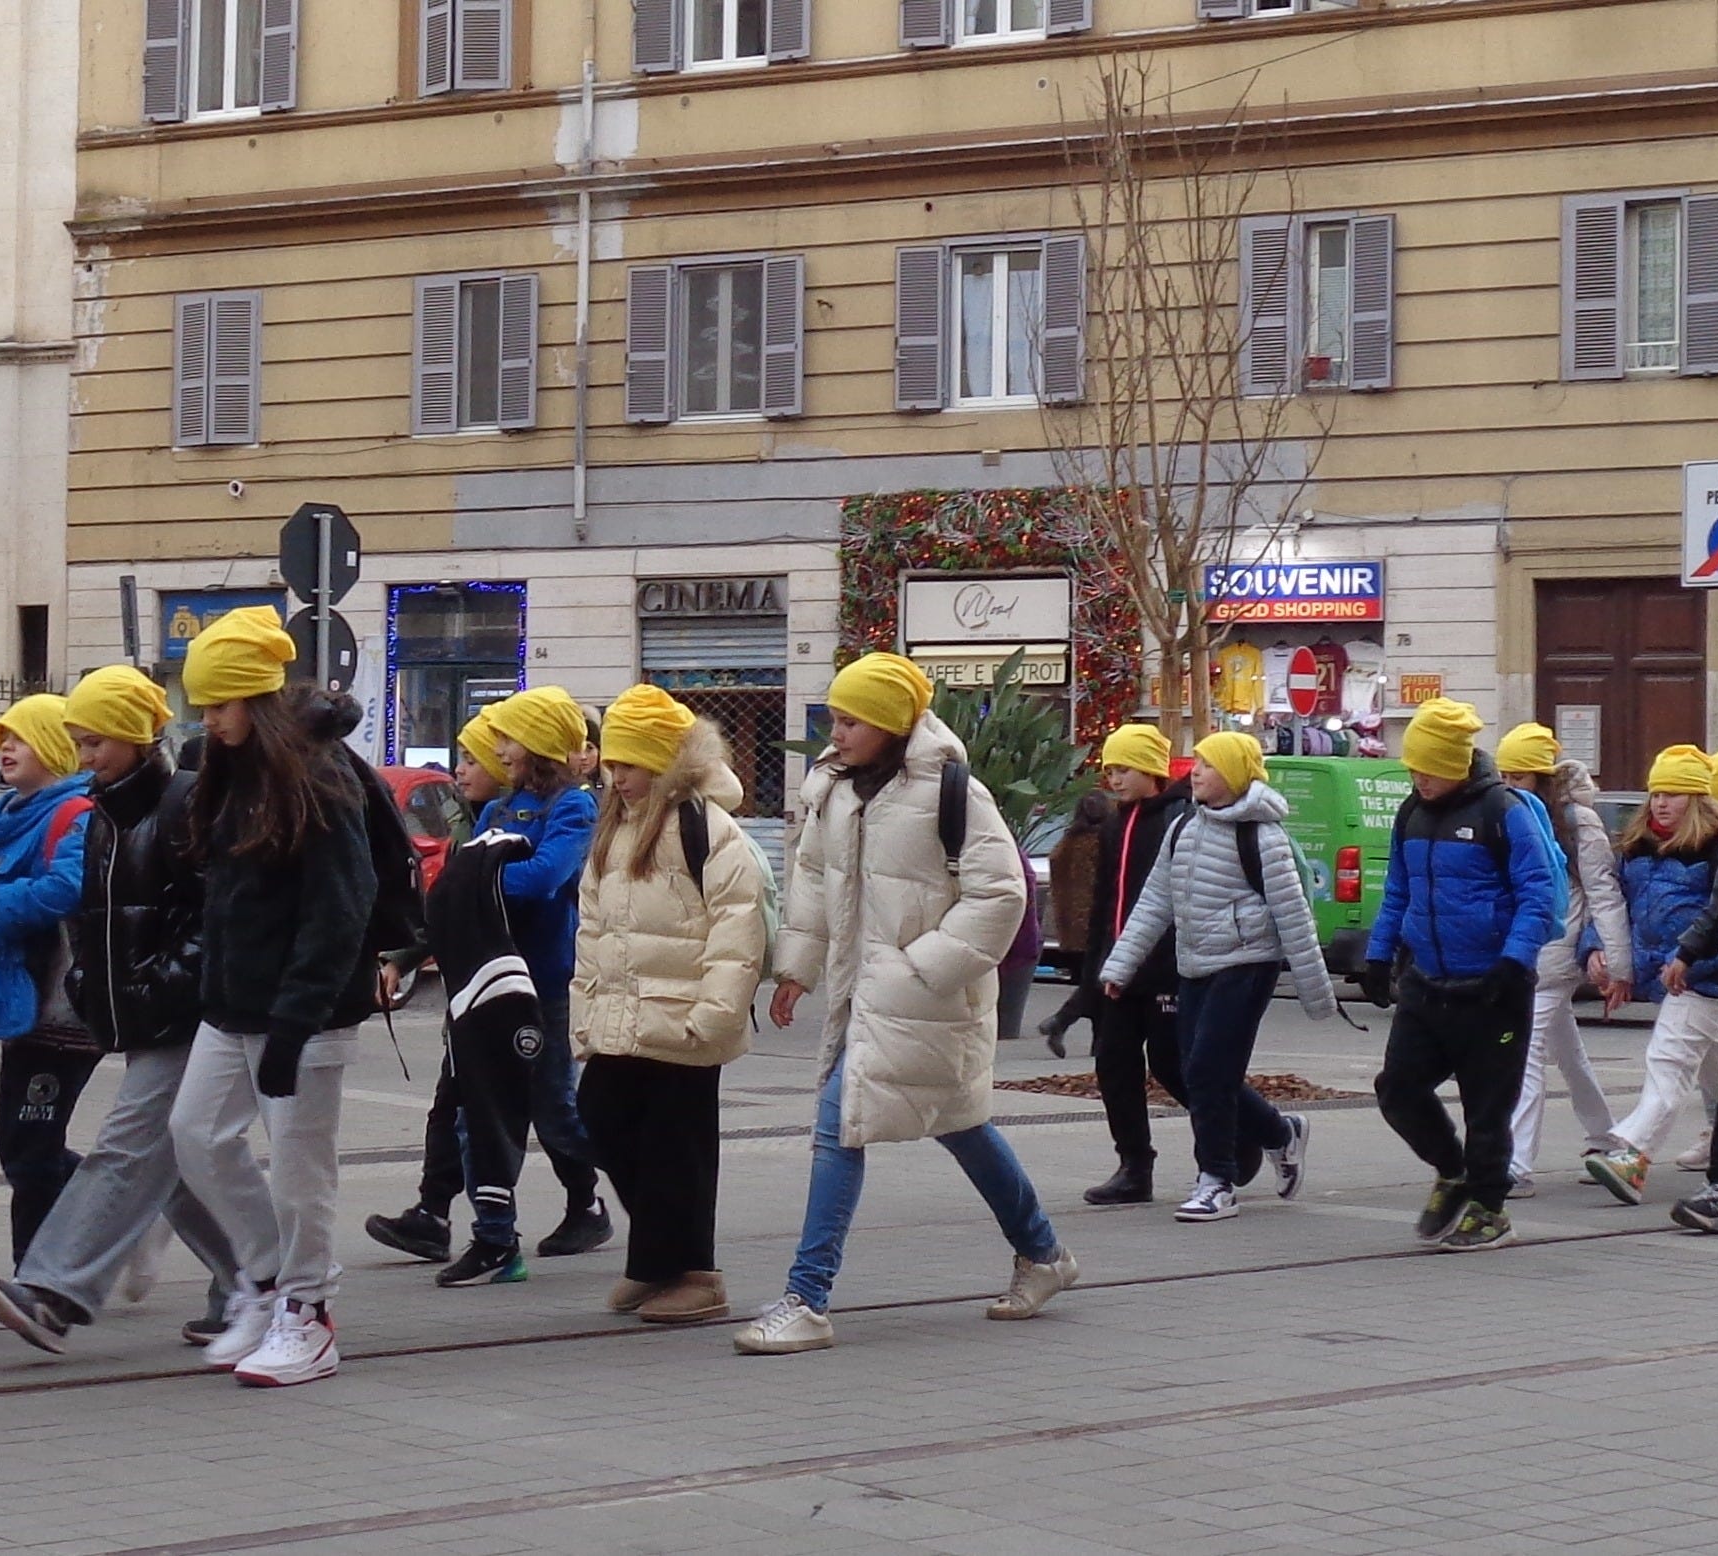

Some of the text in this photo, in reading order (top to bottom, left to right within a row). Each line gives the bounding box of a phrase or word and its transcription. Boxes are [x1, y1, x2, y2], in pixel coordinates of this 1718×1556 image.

[1210, 567, 1376, 597] SOUVENIR
[637, 580, 782, 613] CINEMA
[1273, 601, 1367, 617] SHOPPING
[920, 663, 968, 682] AFFE'
[975, 663, 985, 682] E
[1317, 663, 1336, 692] 21
[1356, 779, 1373, 792] TO
[1359, 796, 1385, 810] THE
